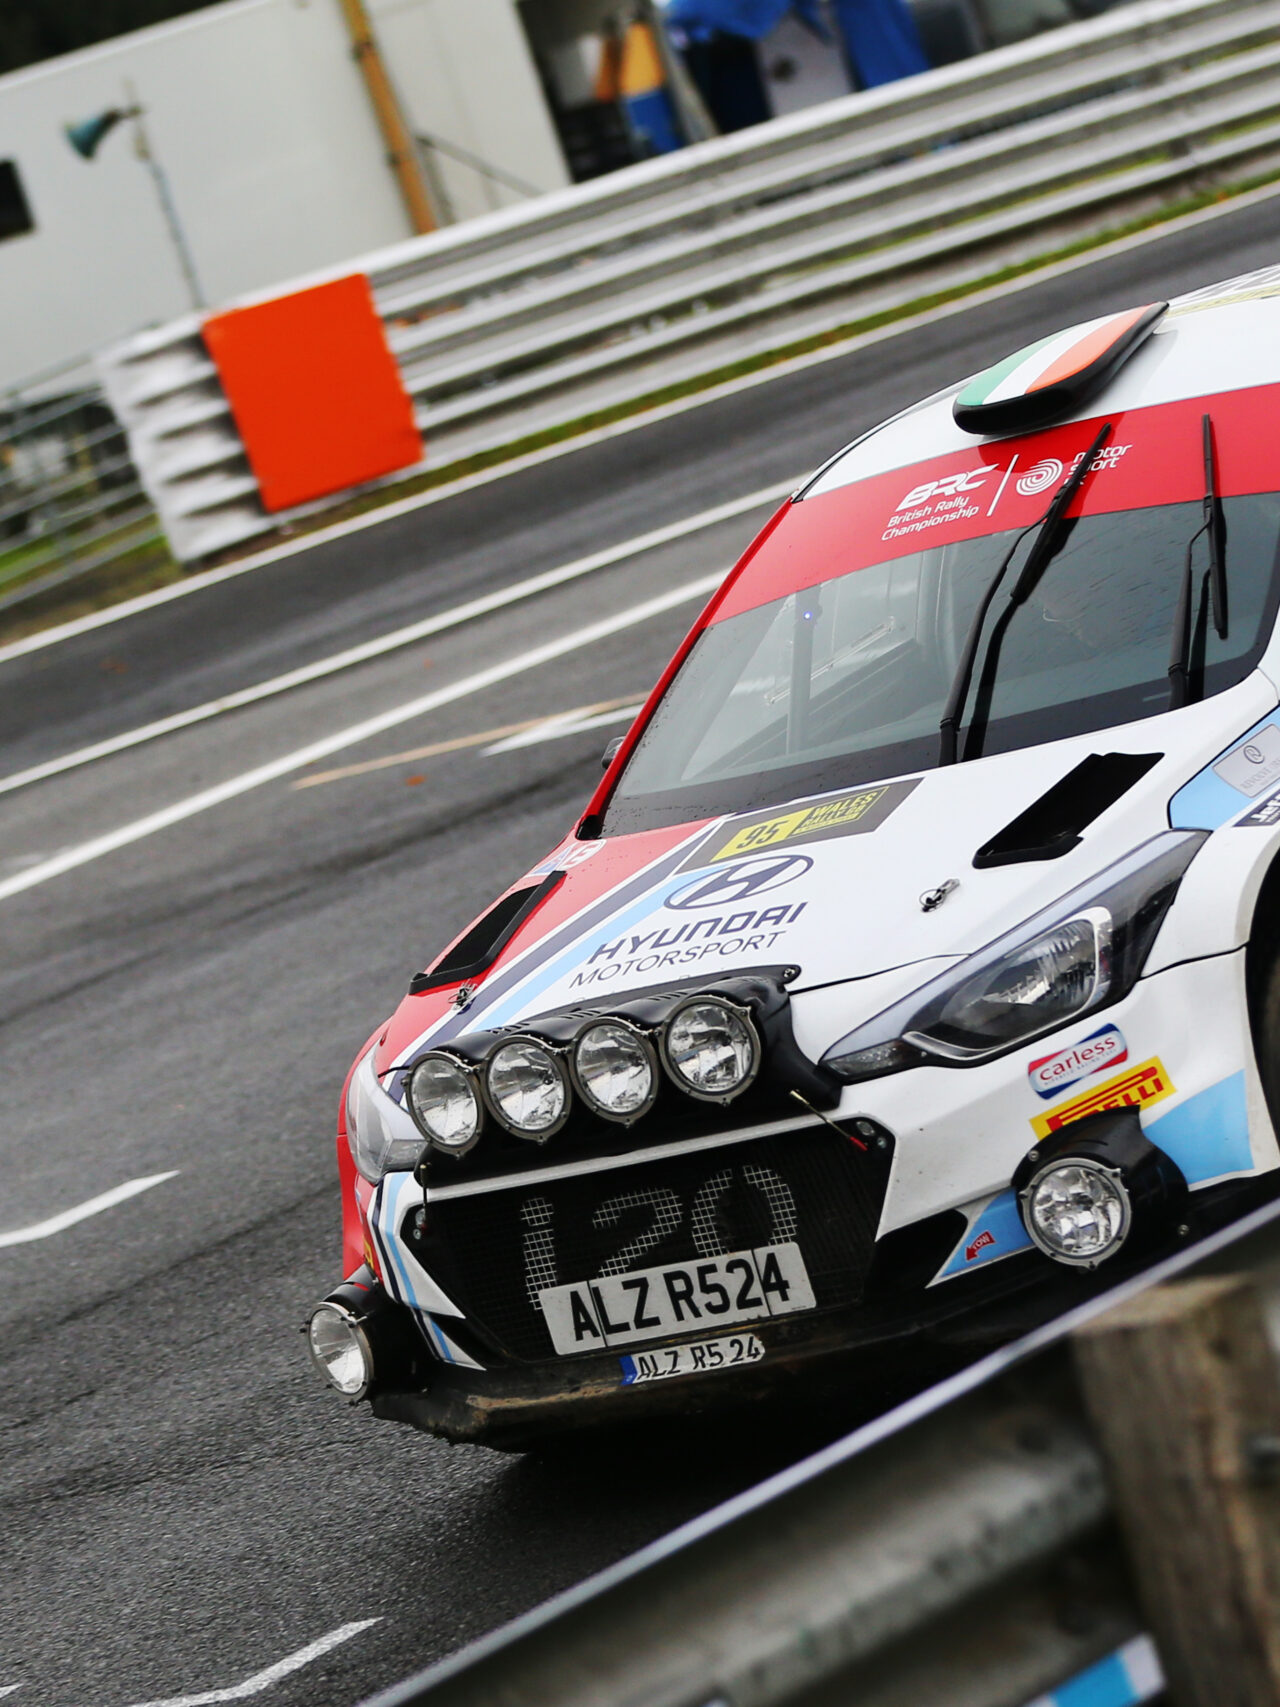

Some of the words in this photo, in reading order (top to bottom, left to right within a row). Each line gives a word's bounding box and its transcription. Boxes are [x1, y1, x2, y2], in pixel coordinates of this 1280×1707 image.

[1068, 457, 1120, 476] sort
[895, 463, 1000, 512] BRC
[881, 505, 979, 541] Championship
[887, 505, 932, 528] British
[934, 496, 970, 513] Rally
[812, 791, 878, 818] WALES
[736, 820, 789, 849] 95
[587, 902, 808, 965] HYUNDAI
[568, 930, 787, 990] MOTORSPORT
[1039, 1037, 1116, 1081] carless
[972, 1234, 991, 1250] TOW
[569, 1277, 661, 1342] ALZ
[663, 1252, 791, 1322] R524
[636, 1350, 681, 1380] ALZ
